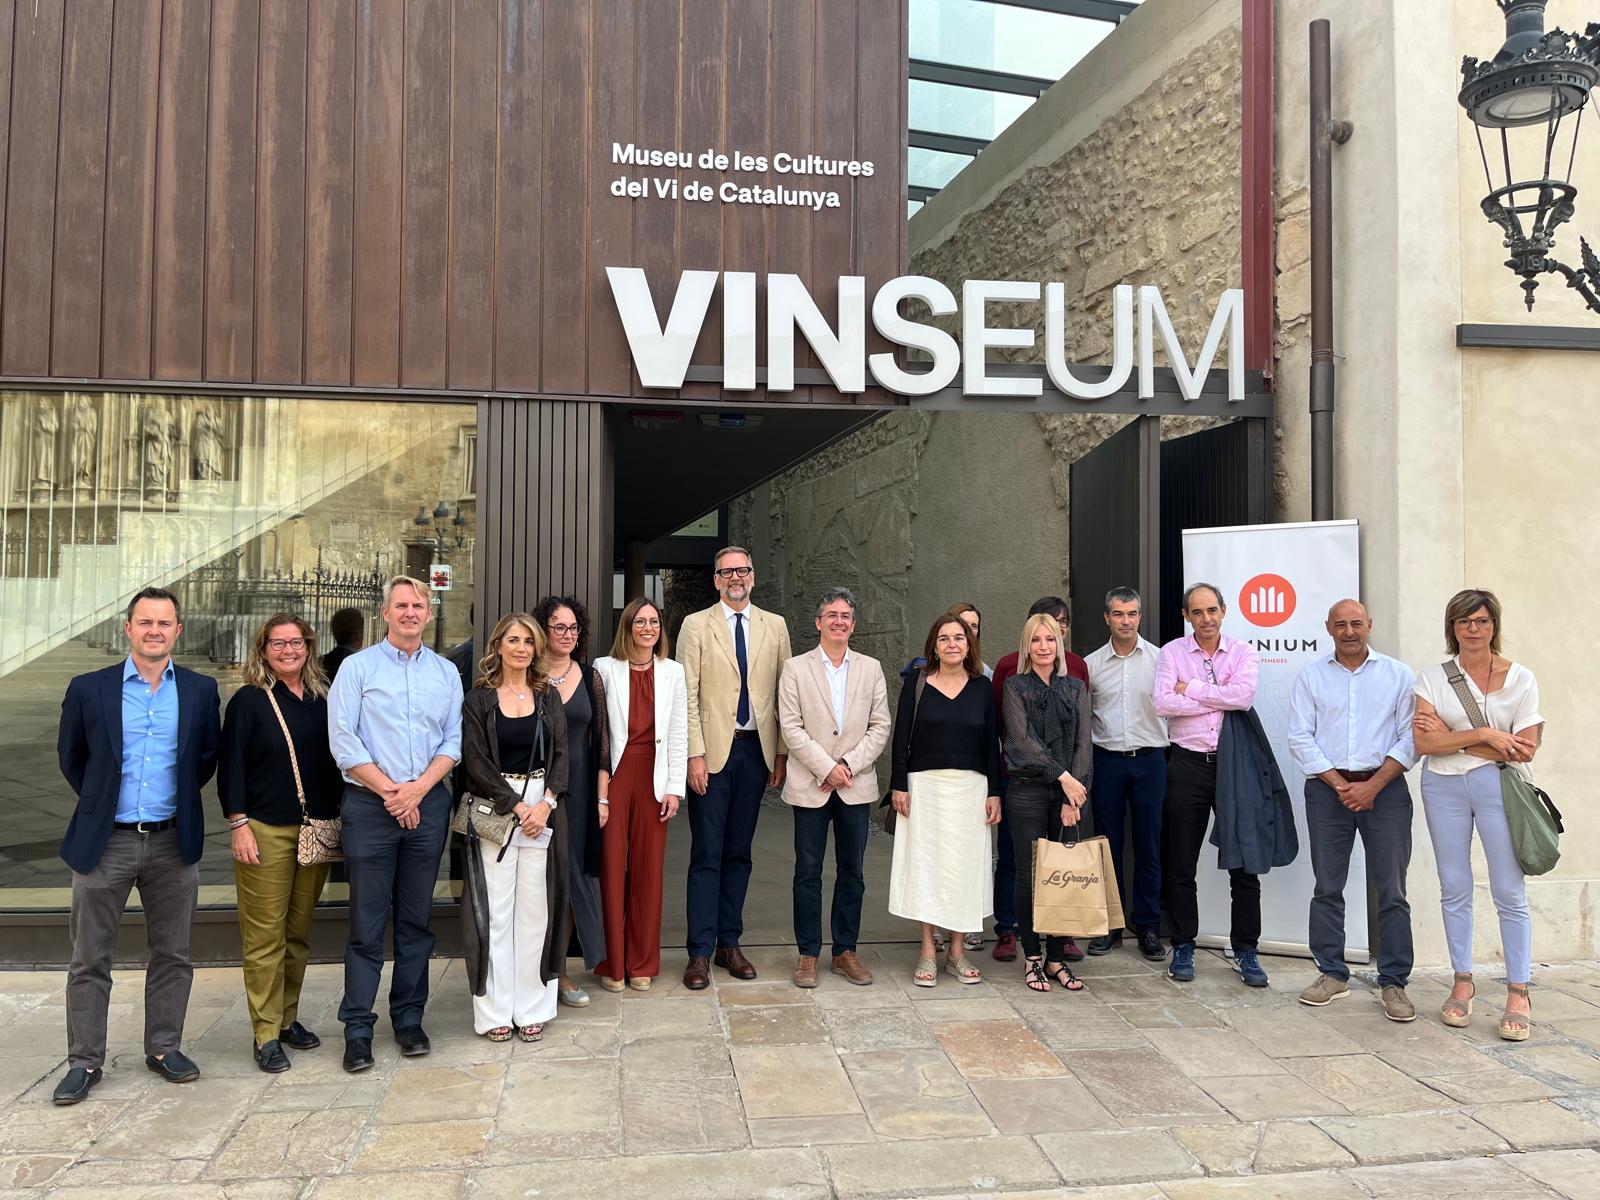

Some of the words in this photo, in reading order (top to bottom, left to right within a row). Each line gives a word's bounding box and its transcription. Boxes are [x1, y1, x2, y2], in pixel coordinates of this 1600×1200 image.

[612, 142, 693, 169] Museu
[698, 149, 729, 171] de
[734, 151, 769, 173] les
[773, 152, 875, 177] Cultures
[610, 176, 648, 198] del
[653, 178, 678, 200] Vi
[683, 181, 714, 202] de
[719, 182, 841, 212] Catalunya
[605, 267, 1245, 402] VINSEUM
[1248, 639, 1317, 652] NIUM
[1041, 870, 1061, 885] La
[1060, 870, 1099, 889] Granja
